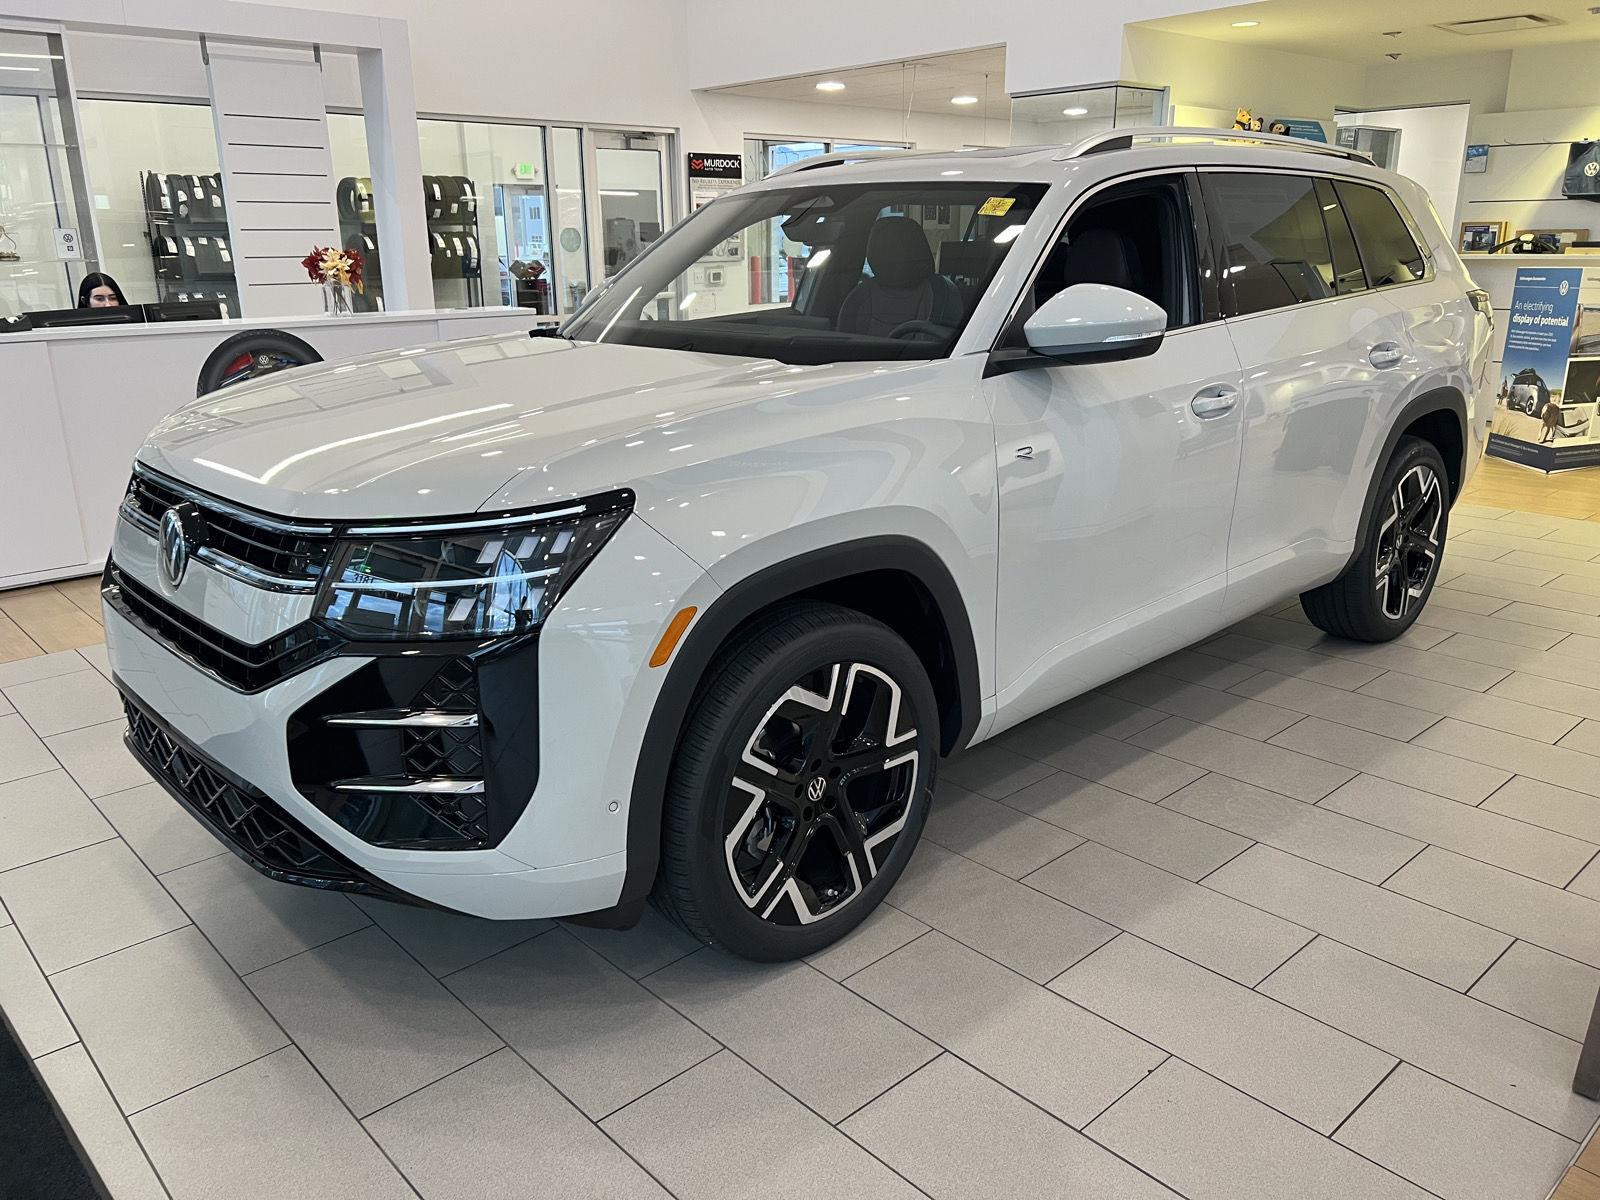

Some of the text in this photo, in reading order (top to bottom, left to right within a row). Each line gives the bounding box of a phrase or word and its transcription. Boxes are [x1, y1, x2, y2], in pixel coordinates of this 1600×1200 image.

[704, 159, 740, 168] MURDOCK
[1514, 300, 1554, 314] An electrifying
[1512, 314, 1569, 327] display of potential
